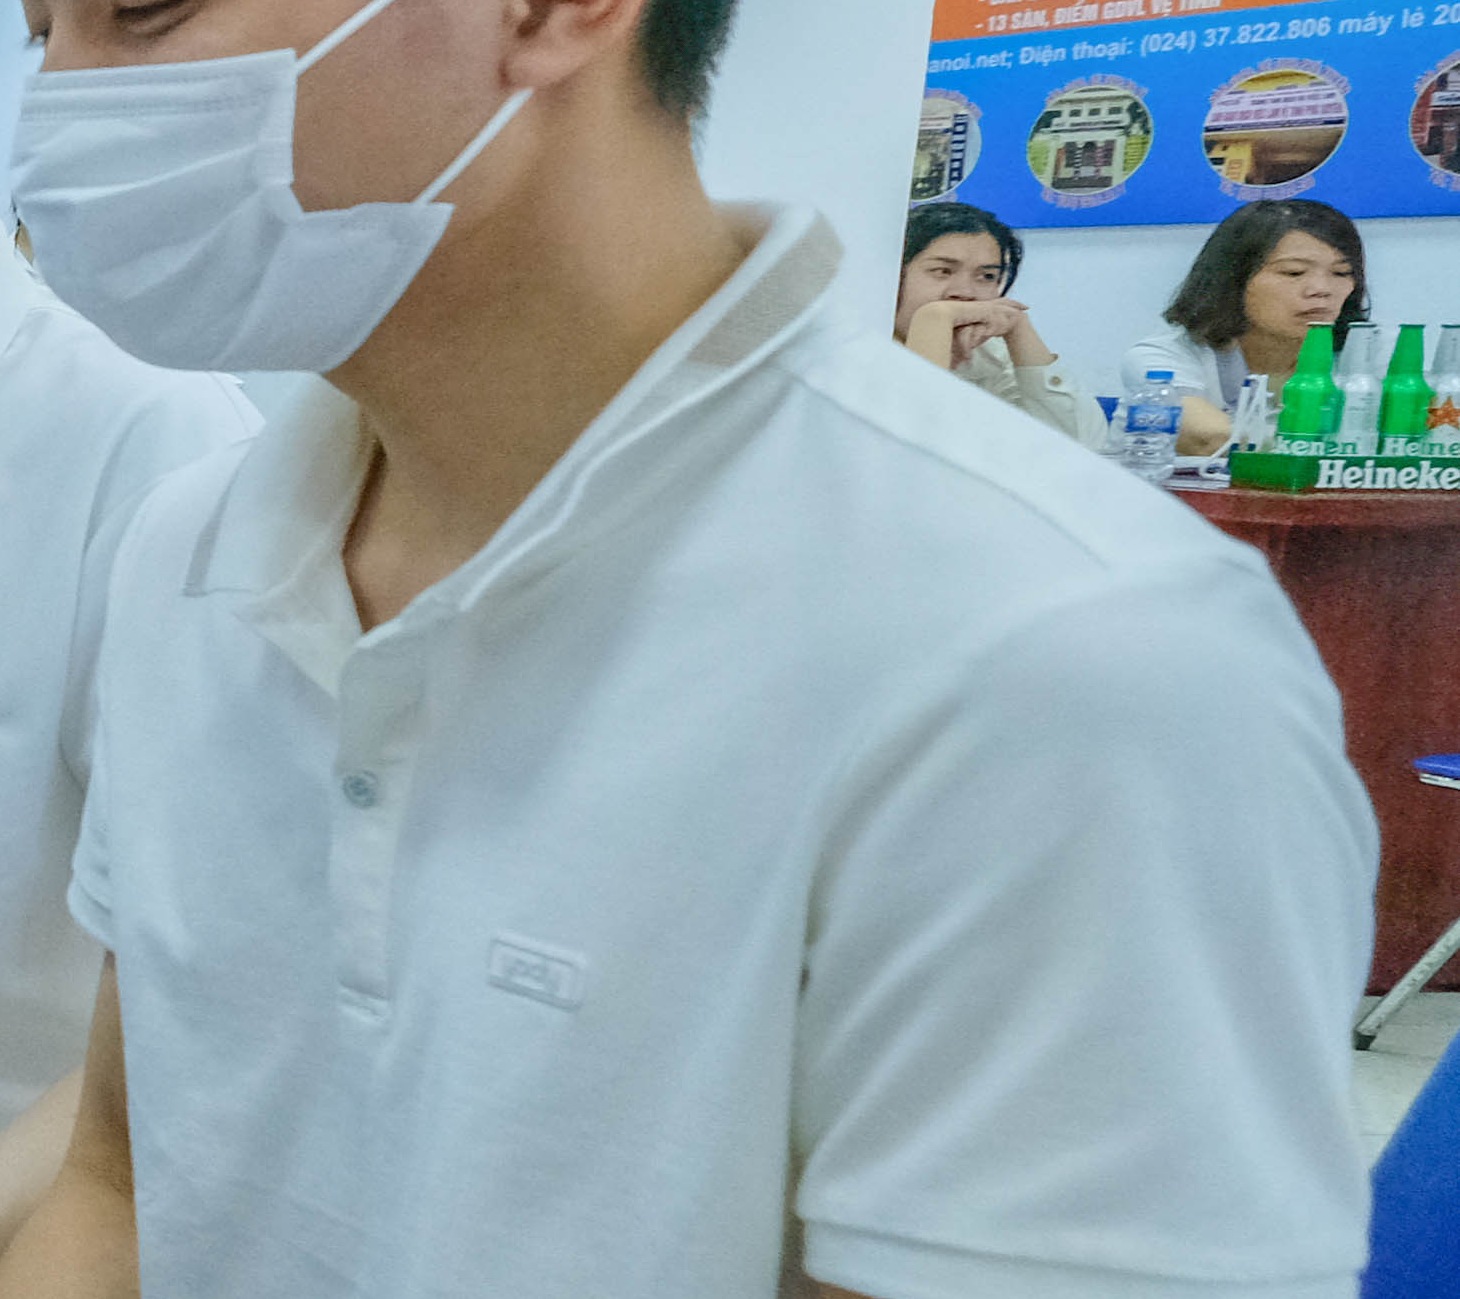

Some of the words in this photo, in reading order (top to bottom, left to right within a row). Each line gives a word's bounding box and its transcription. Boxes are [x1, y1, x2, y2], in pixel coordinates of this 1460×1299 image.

[987, 14, 1007, 32] 13
[1019, 44, 1067, 68] Điện
[1072, 36, 1135, 62] thoại:
[1140, 29, 1197, 57] (024)
[1202, 16, 1332, 49] 37.822.806
[1338, 11, 1395, 37] máy
[1314, 458, 1460, 490] Heineke
